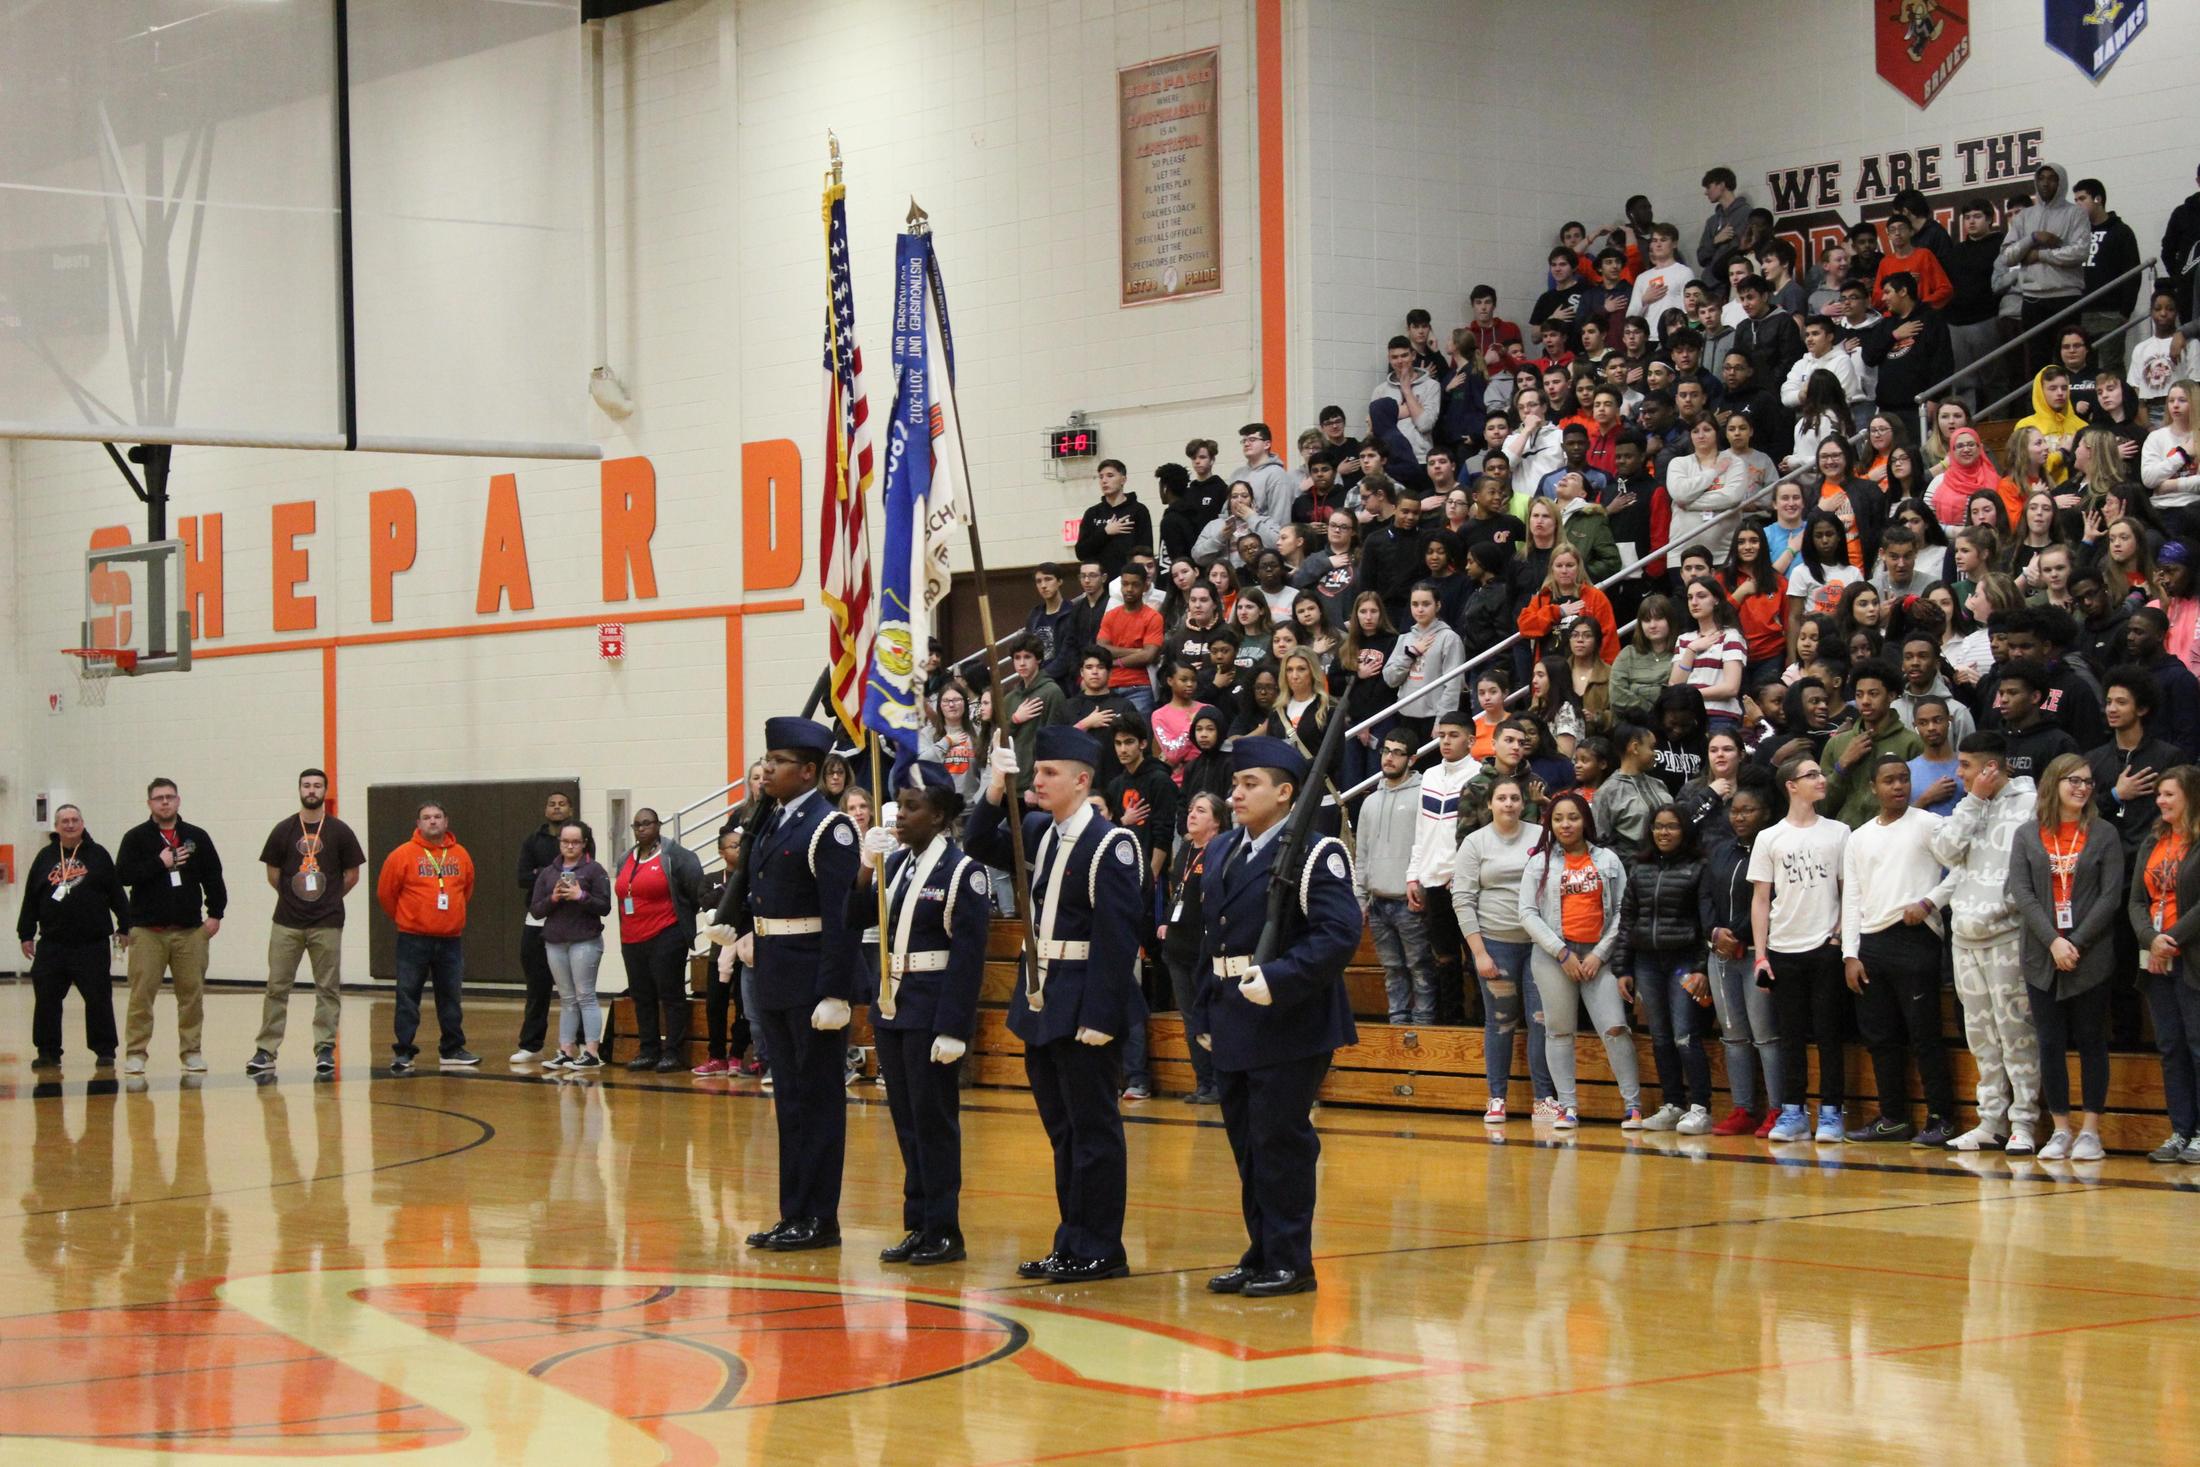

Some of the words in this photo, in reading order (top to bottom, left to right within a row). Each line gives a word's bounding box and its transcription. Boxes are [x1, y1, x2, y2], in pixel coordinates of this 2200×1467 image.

[2093, 1, 2145, 71] HAWKS
[1924, 35, 1969, 100] BRAVES
[1162, 154, 1186, 167] PLEASE
[1157, 170, 1168, 181] LET
[1170, 168, 1181, 177] THE
[1767, 160, 1841, 215] WE
[1854, 144, 1942, 203] ARE
[1955, 127, 2044, 186] THE
[1145, 183, 1173, 194] PLAYERS
[1174, 179, 1191, 190] PLAY
[1157, 195, 1168, 205] LET
[1170, 192, 1181, 201] THE
[1142, 207, 1172, 220] COACHES
[1172, 203, 1196, 216] COACH
[1157, 220, 1168, 230] LET
[1170, 217, 1181, 227] THE
[1135, 231, 1169, 246] OFFICIALS
[1158, 244, 1169, 254] LET
[1170, 242, 1182, 251] THE
[1129, 256, 1169, 272] SPECTATORS
[1178, 251, 1210, 264] POSITIVE
[1184, 267, 1217, 285] PRIDE
[910, 257, 922, 331] DISTINGUISHED
[895, 336, 905, 356] UNIT
[909, 336, 922, 359] UNIT
[909, 368, 923, 424] 2011-2012
[89, 438, 803, 649] SHEPARD
[1653, 750, 1701, 773] PINK
